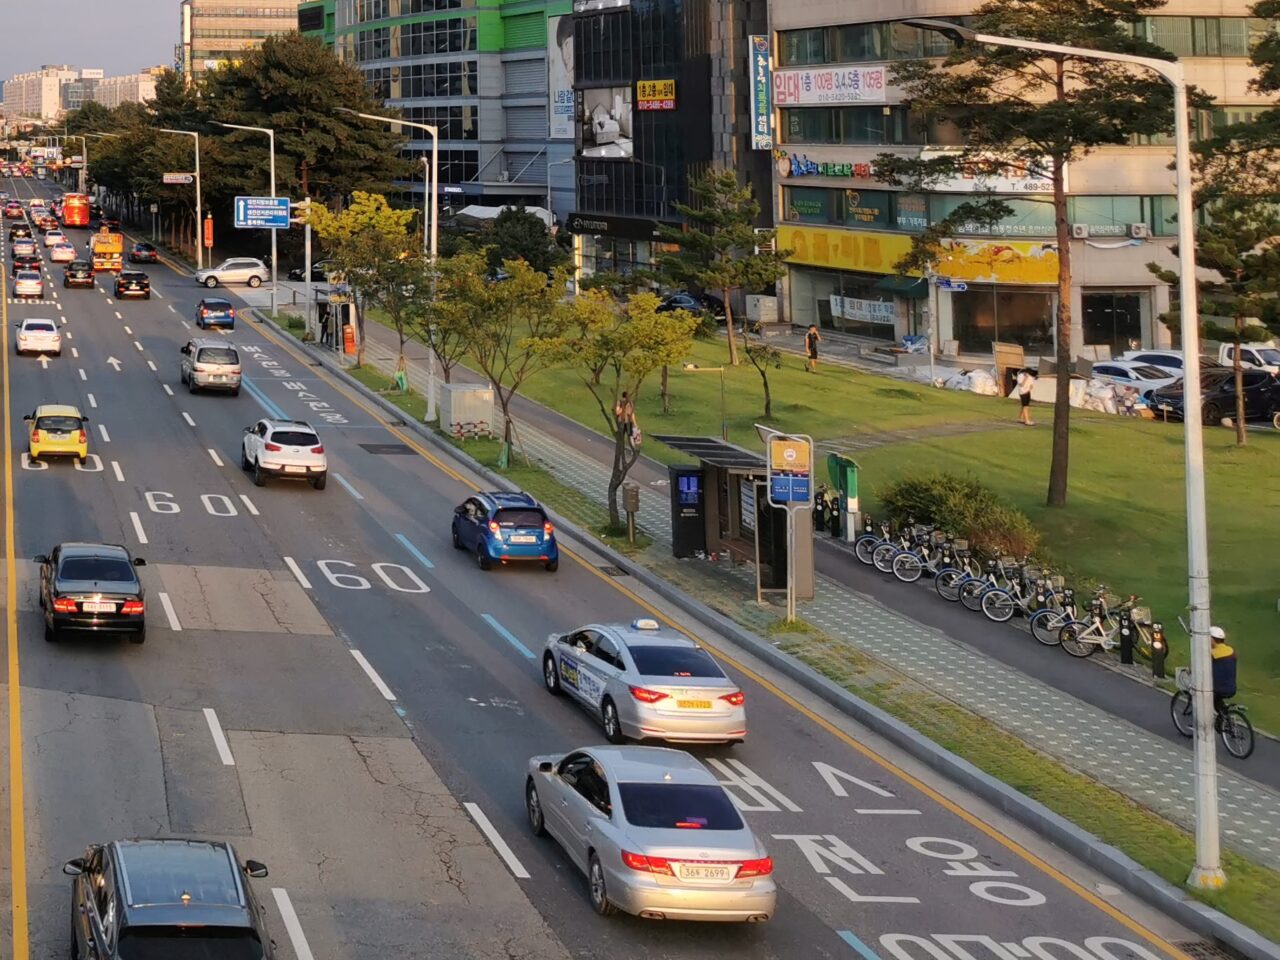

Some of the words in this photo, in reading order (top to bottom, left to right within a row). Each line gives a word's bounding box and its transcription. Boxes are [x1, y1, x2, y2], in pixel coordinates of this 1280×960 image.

[774, 72, 800, 103] 임대
[144, 491, 238, 517] 60
[316, 559, 431, 593] 60
[704, 868, 725, 878] 2699
